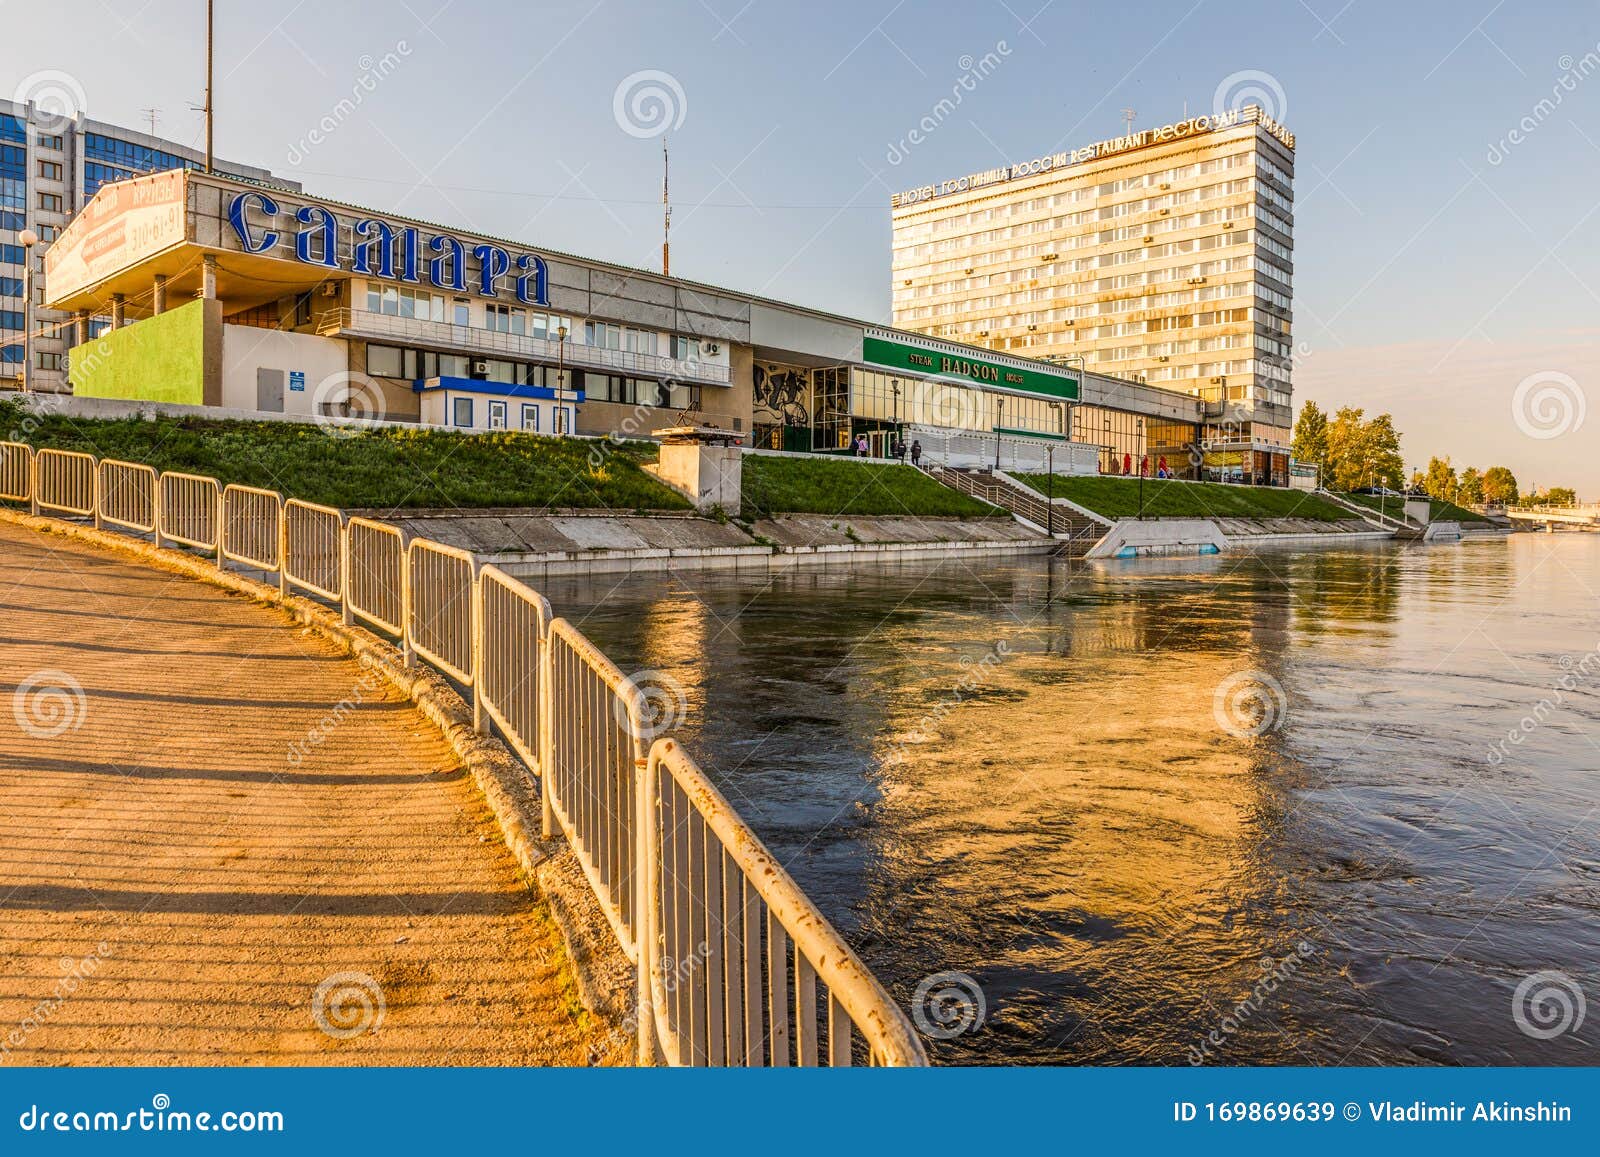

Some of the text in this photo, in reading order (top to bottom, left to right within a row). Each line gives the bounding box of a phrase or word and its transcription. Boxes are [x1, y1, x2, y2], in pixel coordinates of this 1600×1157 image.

[941, 166, 1008, 196] ГОСТИНИЦА
[1011, 151, 1067, 178] РОССИЯ
[909, 353, 933, 367] STEAK
[941, 356, 999, 382] HADSON
